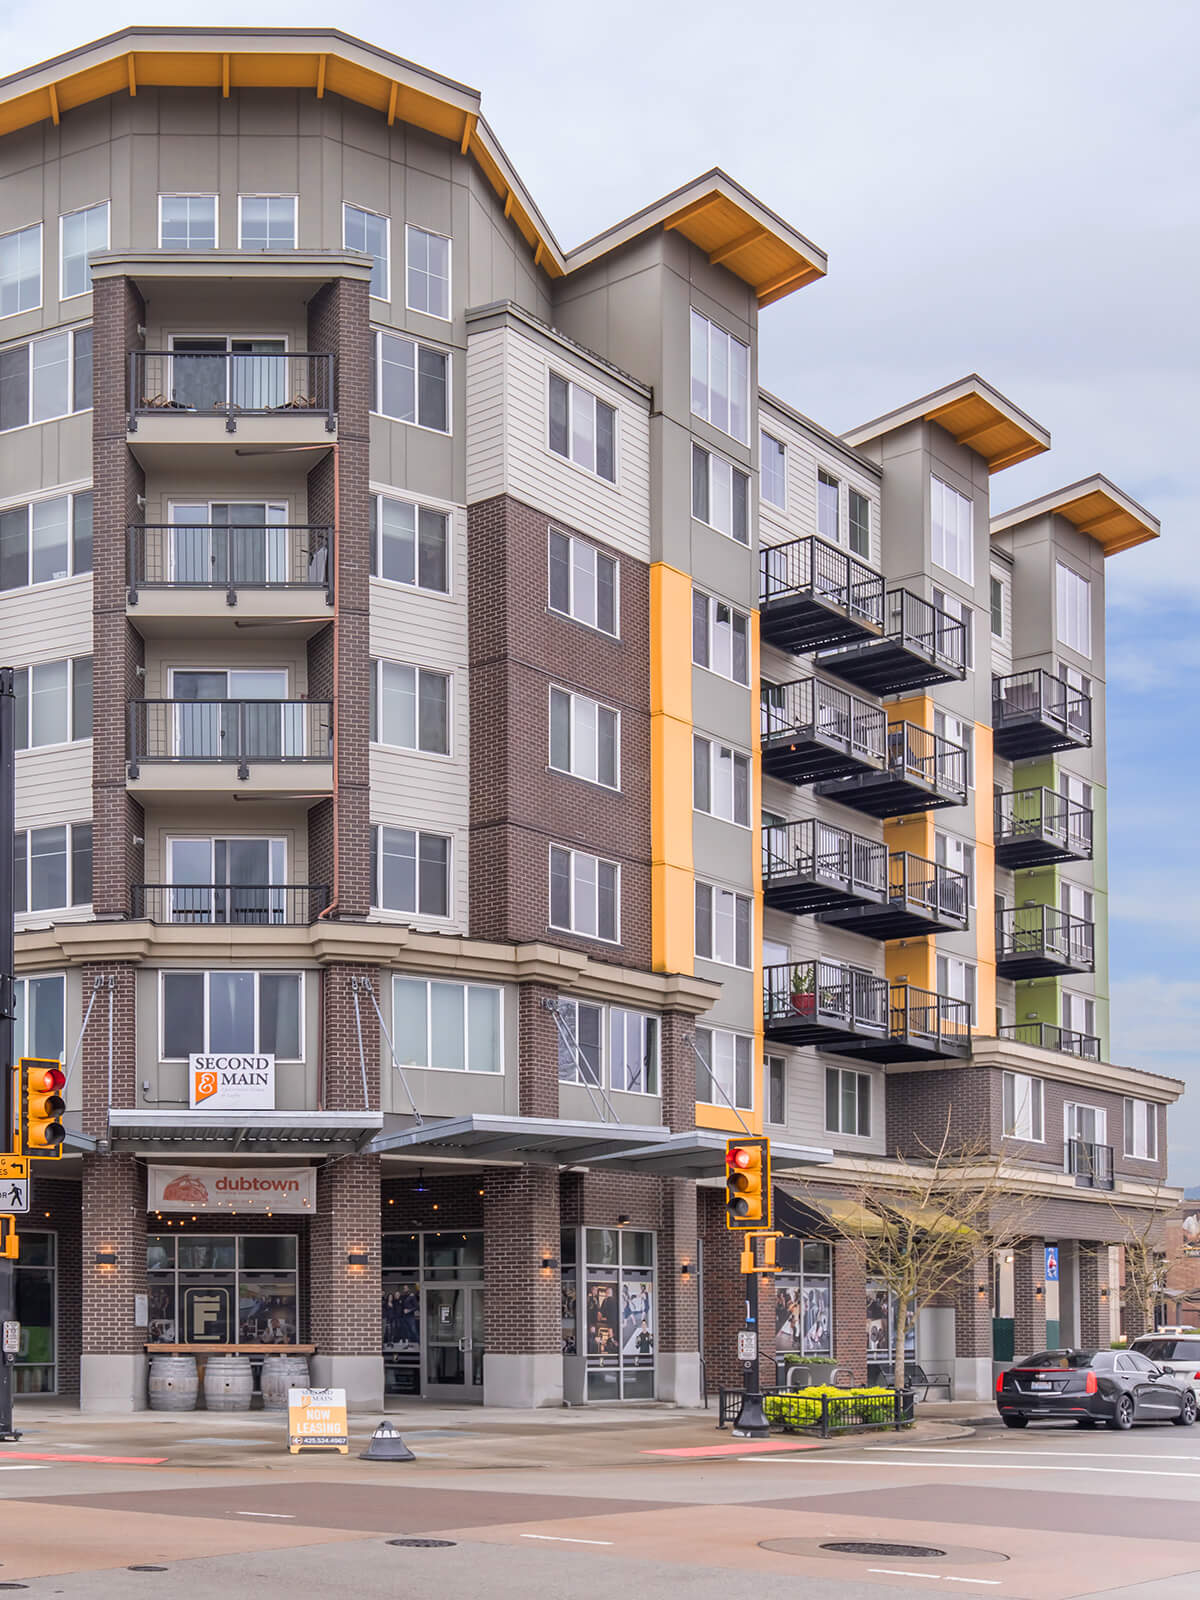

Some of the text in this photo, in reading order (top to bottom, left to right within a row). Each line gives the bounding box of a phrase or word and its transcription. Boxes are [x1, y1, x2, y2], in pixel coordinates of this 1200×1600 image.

[195, 1057, 269, 1070] SECOND
[221, 1073, 269, 1086] MAIN
[215, 1176, 300, 1191] dubtown
[193, 1302, 220, 1334] F
[306, 1408, 331, 1421] NOW
[296, 1423, 342, 1434] LEASING
